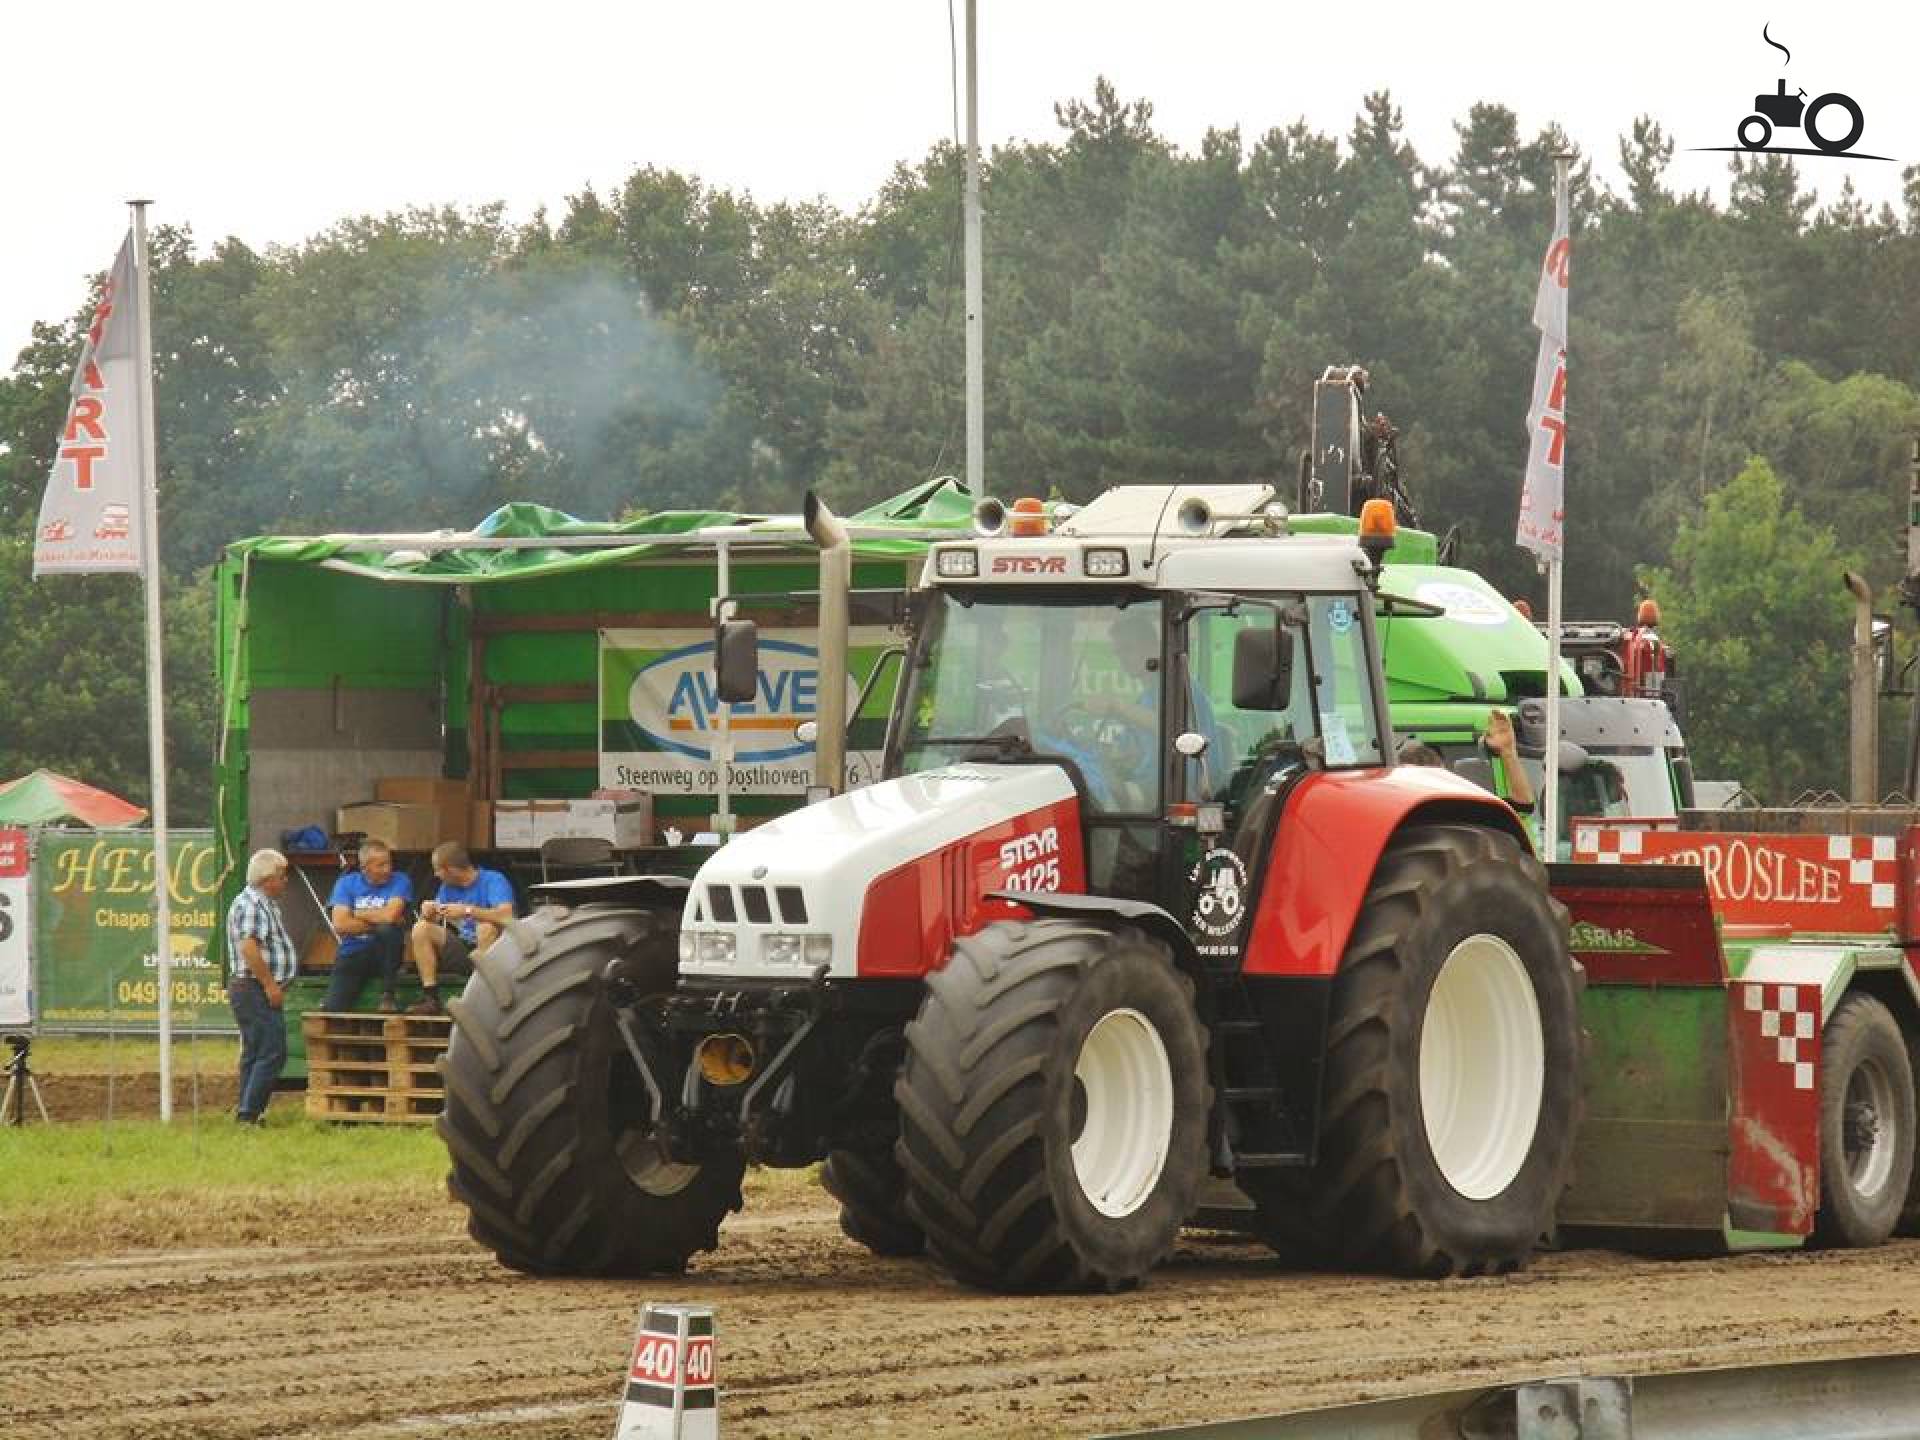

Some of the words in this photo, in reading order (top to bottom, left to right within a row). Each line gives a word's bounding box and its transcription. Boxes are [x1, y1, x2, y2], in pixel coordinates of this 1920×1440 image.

[991, 556, 1067, 573] STEYR
[668, 670, 818, 730] AVVE
[616, 764, 693, 791] Steenweg
[697, 769, 719, 791] op
[1000, 827, 1059, 869] STEYR
[1642, 839, 1842, 903] ROSLEE
[167, 907, 216, 928] solat
[637, 1339, 674, 1378] 40
[687, 1343, 711, 1381] 40
